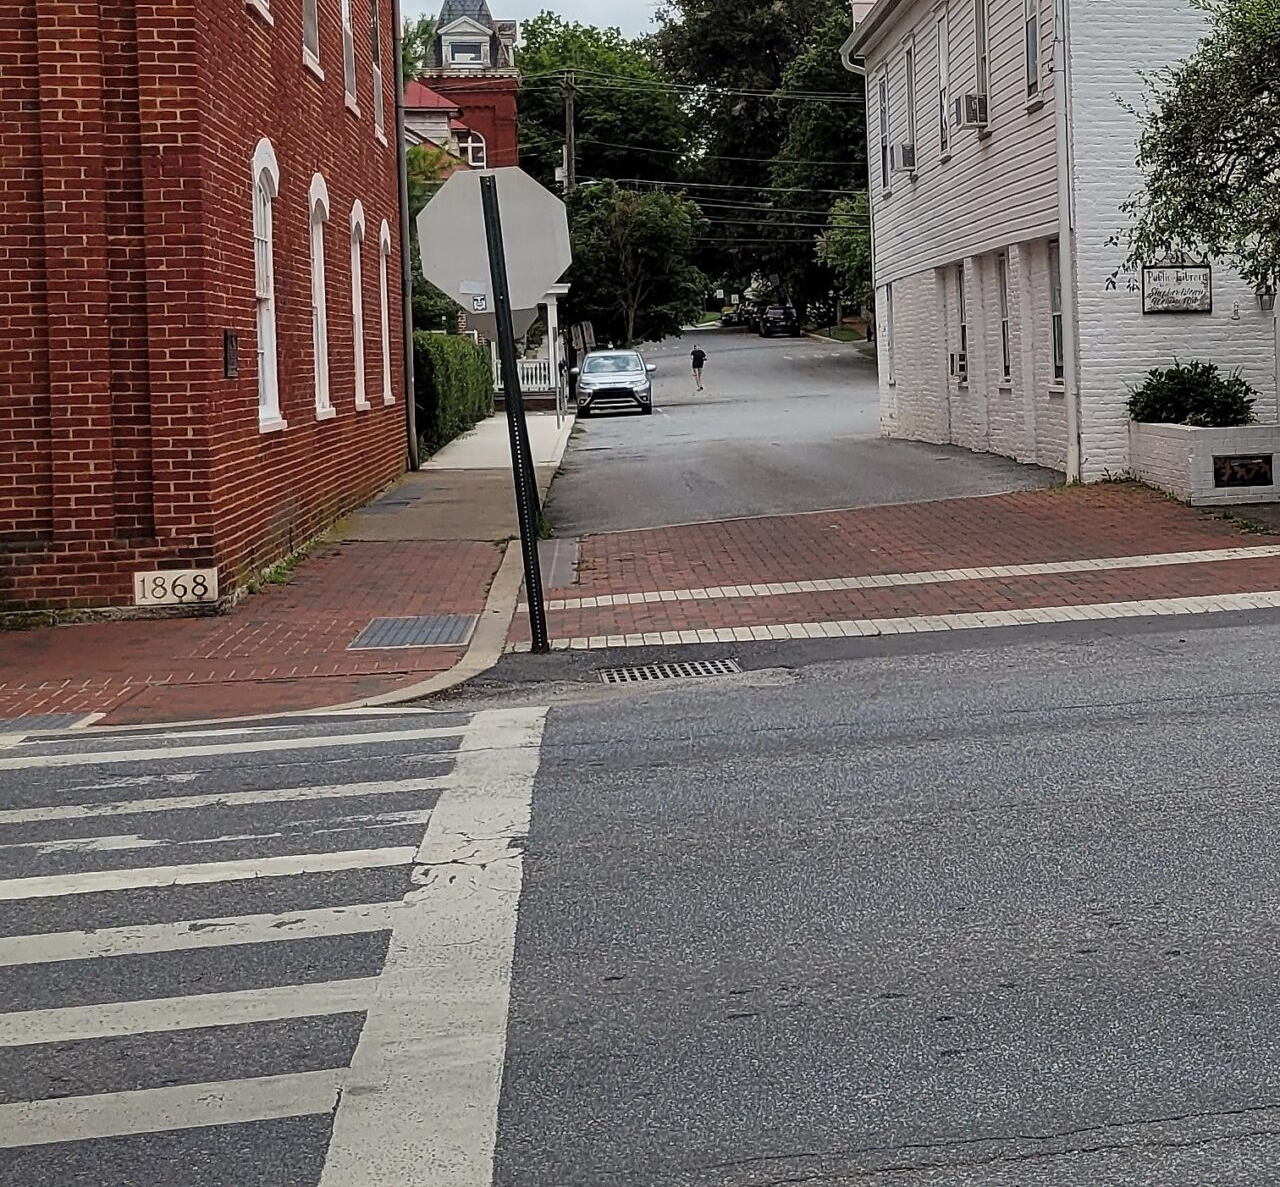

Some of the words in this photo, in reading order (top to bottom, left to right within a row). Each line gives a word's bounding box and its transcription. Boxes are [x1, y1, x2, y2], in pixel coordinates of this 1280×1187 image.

[1147, 270, 1170, 284] Public
[1175, 270, 1208, 285] Library
[139, 574, 208, 599] 1868
